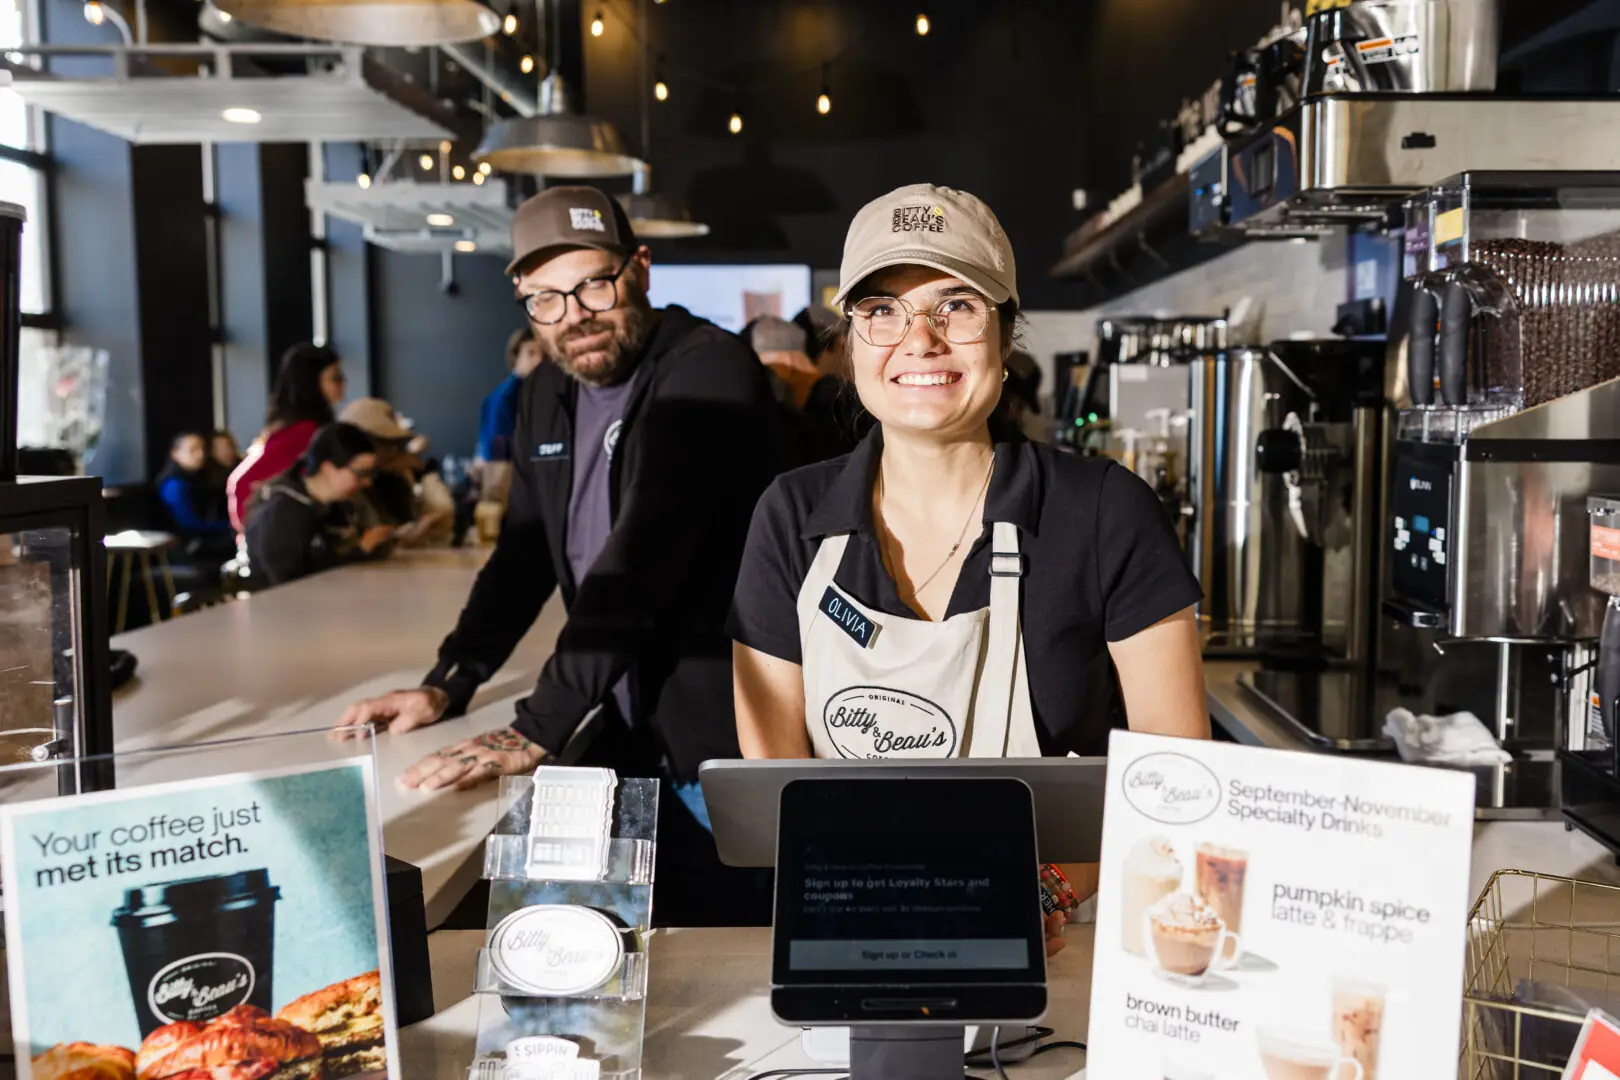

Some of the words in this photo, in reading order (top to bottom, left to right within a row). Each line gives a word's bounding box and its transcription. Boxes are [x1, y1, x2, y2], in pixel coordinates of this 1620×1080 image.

[892, 214, 945, 225] BEAU'S
[893, 206, 931, 217] BITTY
[892, 223, 944, 233] COFFEE
[828, 597, 866, 639] OLIVIA
[868, 694, 905, 706] ORIGINAL
[830, 706, 877, 734] Bitty
[873, 726, 881, 738] &
[874, 726, 947, 753] Beau's
[32, 830, 101, 857] Your
[110, 815, 205, 847] coffee
[213, 801, 261, 836] just
[1228, 799, 1316, 832] Specialty
[1321, 812, 1384, 838] Drinks
[36, 854, 98, 888] met
[107, 852, 142, 876] its
[151, 833, 248, 868] match.
[804, 878, 831, 889] Sign
[834, 879, 849, 890] up
[851, 878, 864, 888] to
[866, 878, 886, 890] get
[889, 877, 931, 890] Loyalty
[968, 878, 990, 888] and
[1272, 901, 1317, 926] latte
[1322, 909, 1336, 929] &
[1273, 883, 1364, 913] pumpkin
[1370, 898, 1431, 924] spice
[886, 951, 899, 961] up
[914, 949, 945, 960] Check
[1126, 992, 1181, 1019] brown
[1186, 1005, 1240, 1032] butter
[1163, 1019, 1201, 1043] latte
